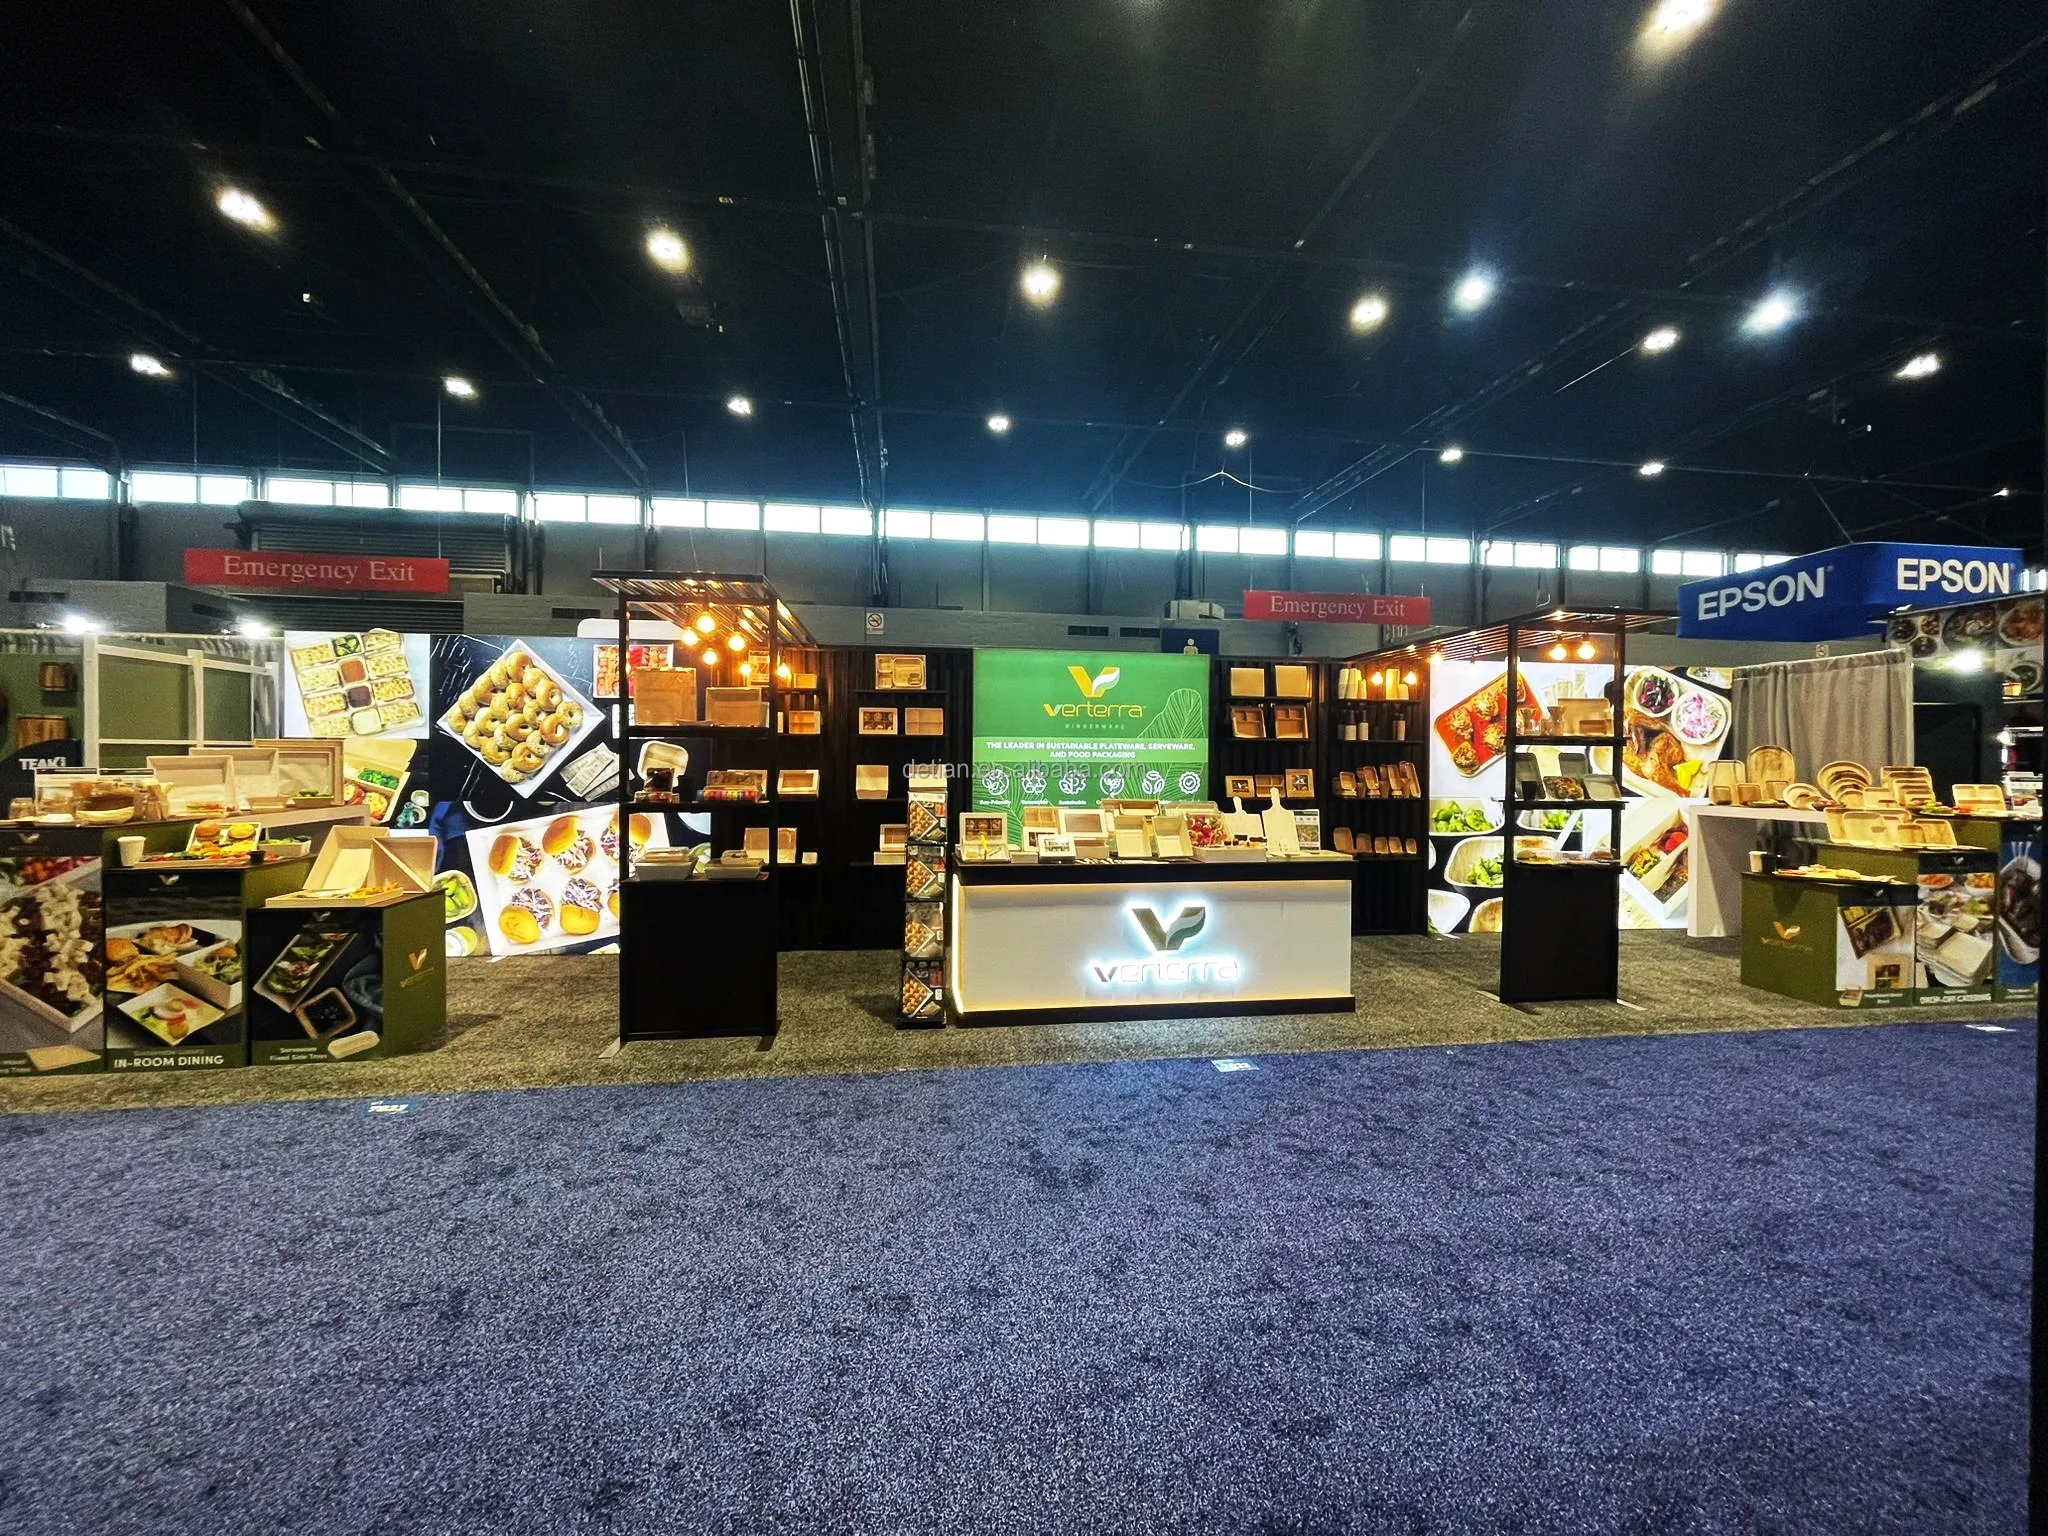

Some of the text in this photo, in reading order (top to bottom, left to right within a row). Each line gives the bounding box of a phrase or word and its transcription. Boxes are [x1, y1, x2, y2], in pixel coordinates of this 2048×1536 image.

[224, 556, 415, 584] Emergency Exit
[1897, 558, 2010, 594] EPSON
[1698, 567, 1825, 621] EPSON
[1270, 595, 1405, 619] Emergency Exit
[1043, 701, 1143, 718] verterra
[1046, 742, 1098, 750] SUSTAINABLE
[1099, 743, 1147, 751] PLATEWARE,
[1148, 743, 1196, 751] SERVEWARE,
[1092, 751, 1136, 759] PACKAGING
[1094, 958, 1238, 983] verterra
[114, 1055, 224, 1068] IN-ROOM DINING
